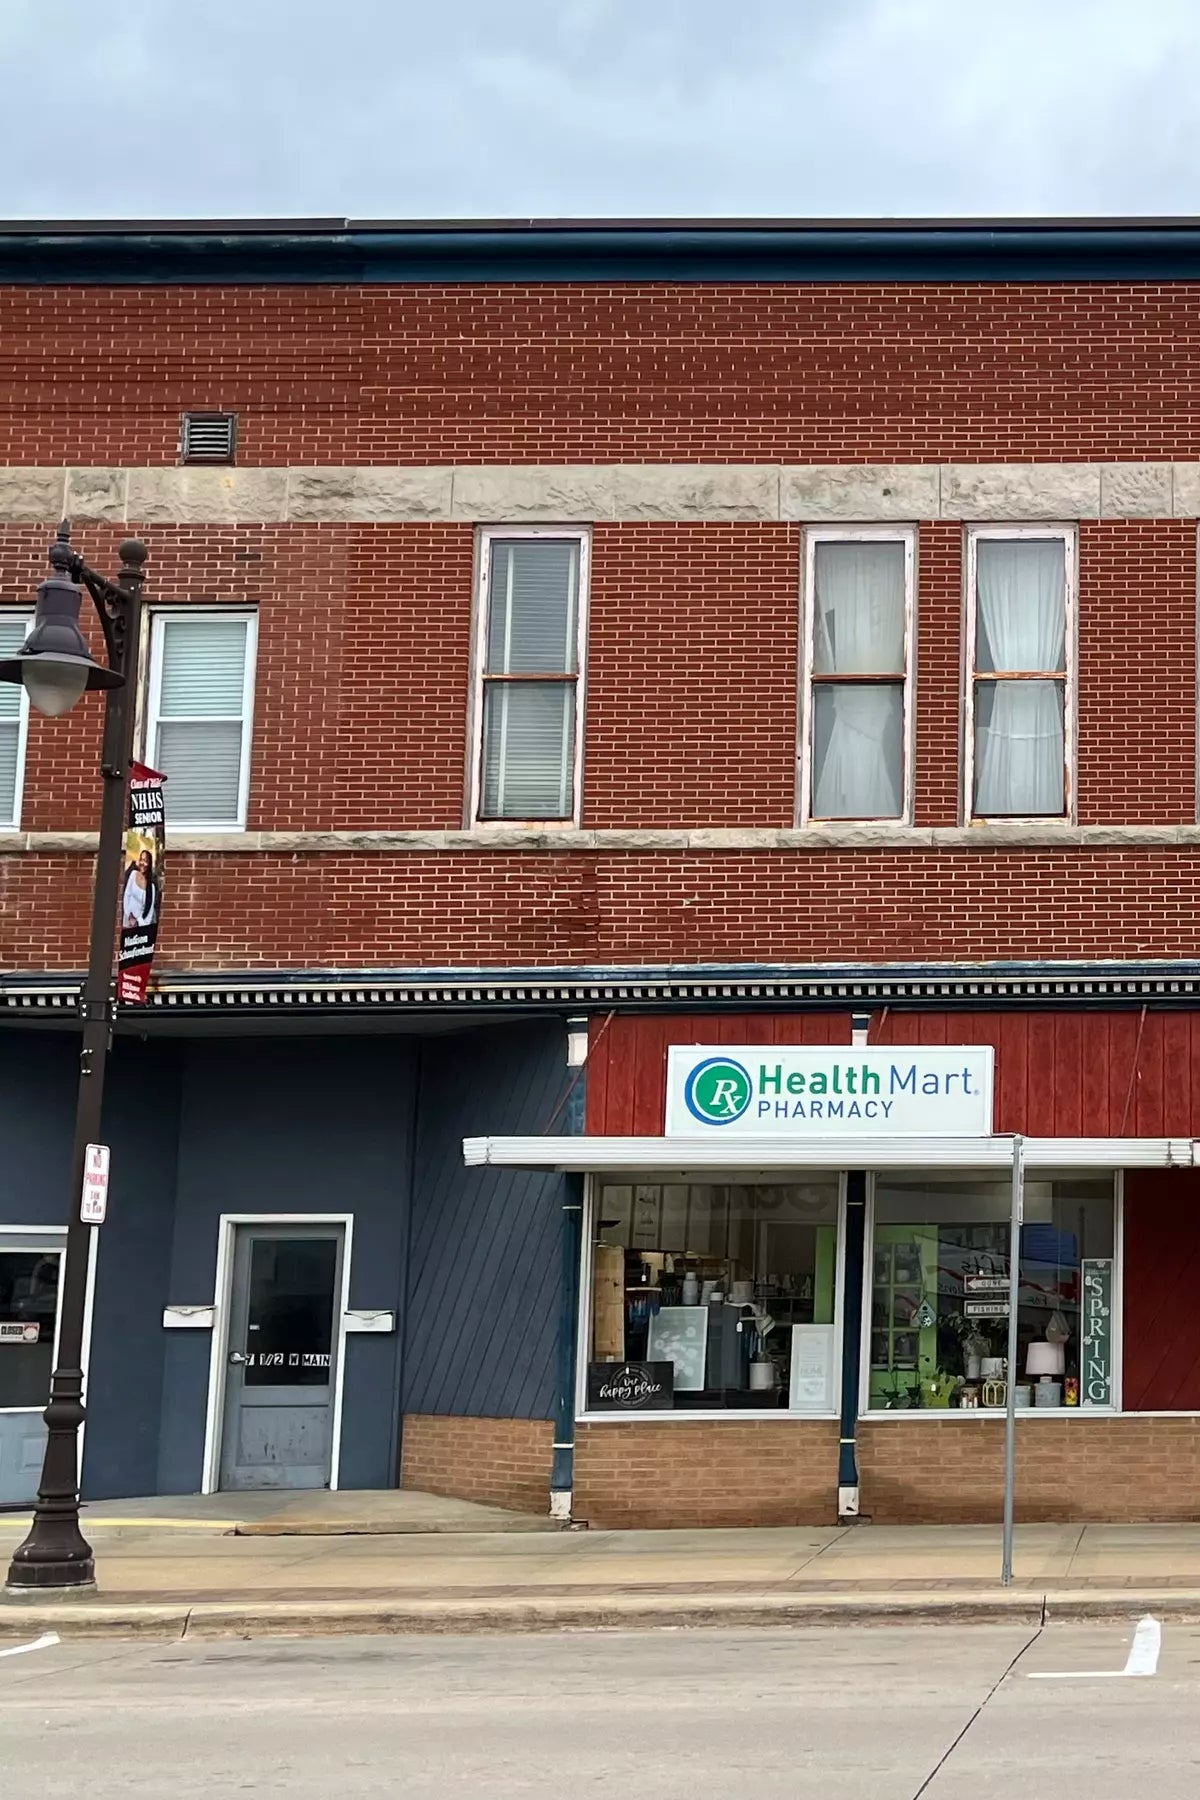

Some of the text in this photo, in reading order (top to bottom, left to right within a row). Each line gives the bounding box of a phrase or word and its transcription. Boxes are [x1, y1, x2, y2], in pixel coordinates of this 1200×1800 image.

[131, 792, 163, 811] NHHS
[135, 811, 163, 825] SENIOR
[759, 1065, 972, 1094] Health Mart
[758, 1101, 893, 1118] PHARMACY
[1087, 1276, 1107, 1401] SPRING
[302, 1353, 332, 1367] MAIN
[634, 1381, 662, 1396] place
